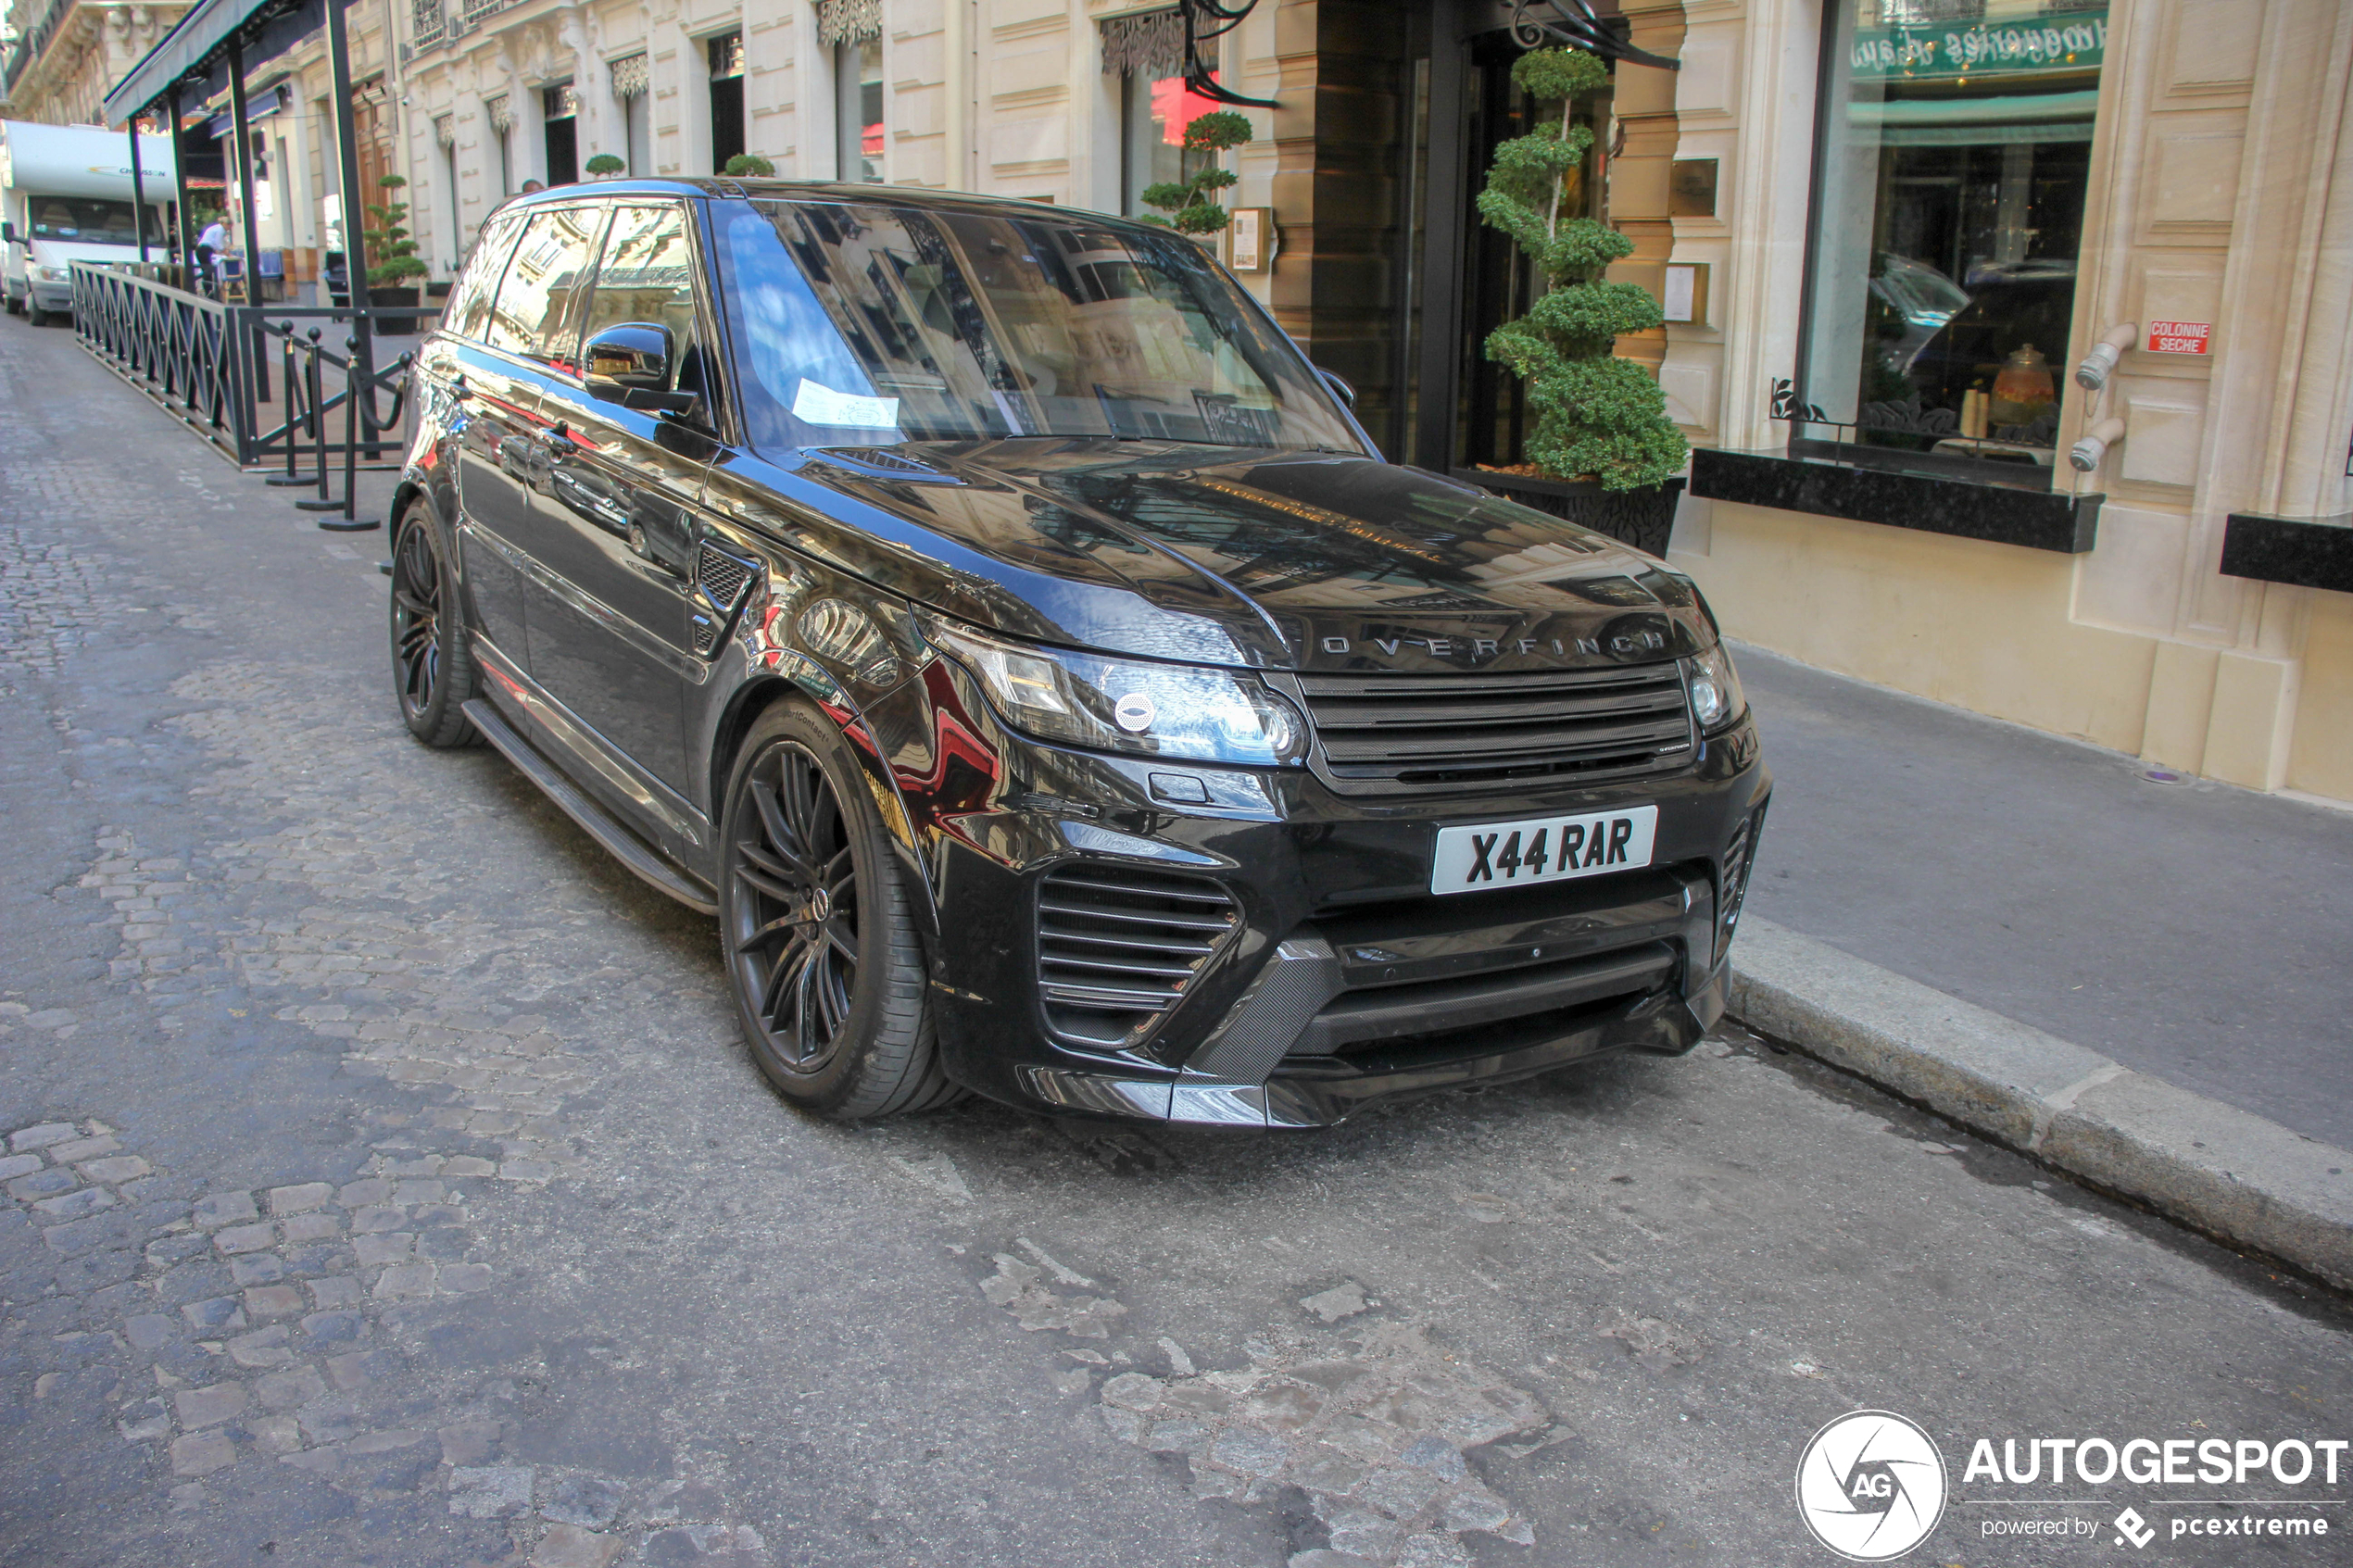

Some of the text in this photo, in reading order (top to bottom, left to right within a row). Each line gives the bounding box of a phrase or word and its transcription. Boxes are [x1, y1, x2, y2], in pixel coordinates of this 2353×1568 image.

[2152, 322, 2208, 338] COLONNE
[2159, 337, 2200, 353] SECHE
[1322, 632, 1665, 657] OVERFINCH
[1466, 818, 1632, 882] X44 RAR
